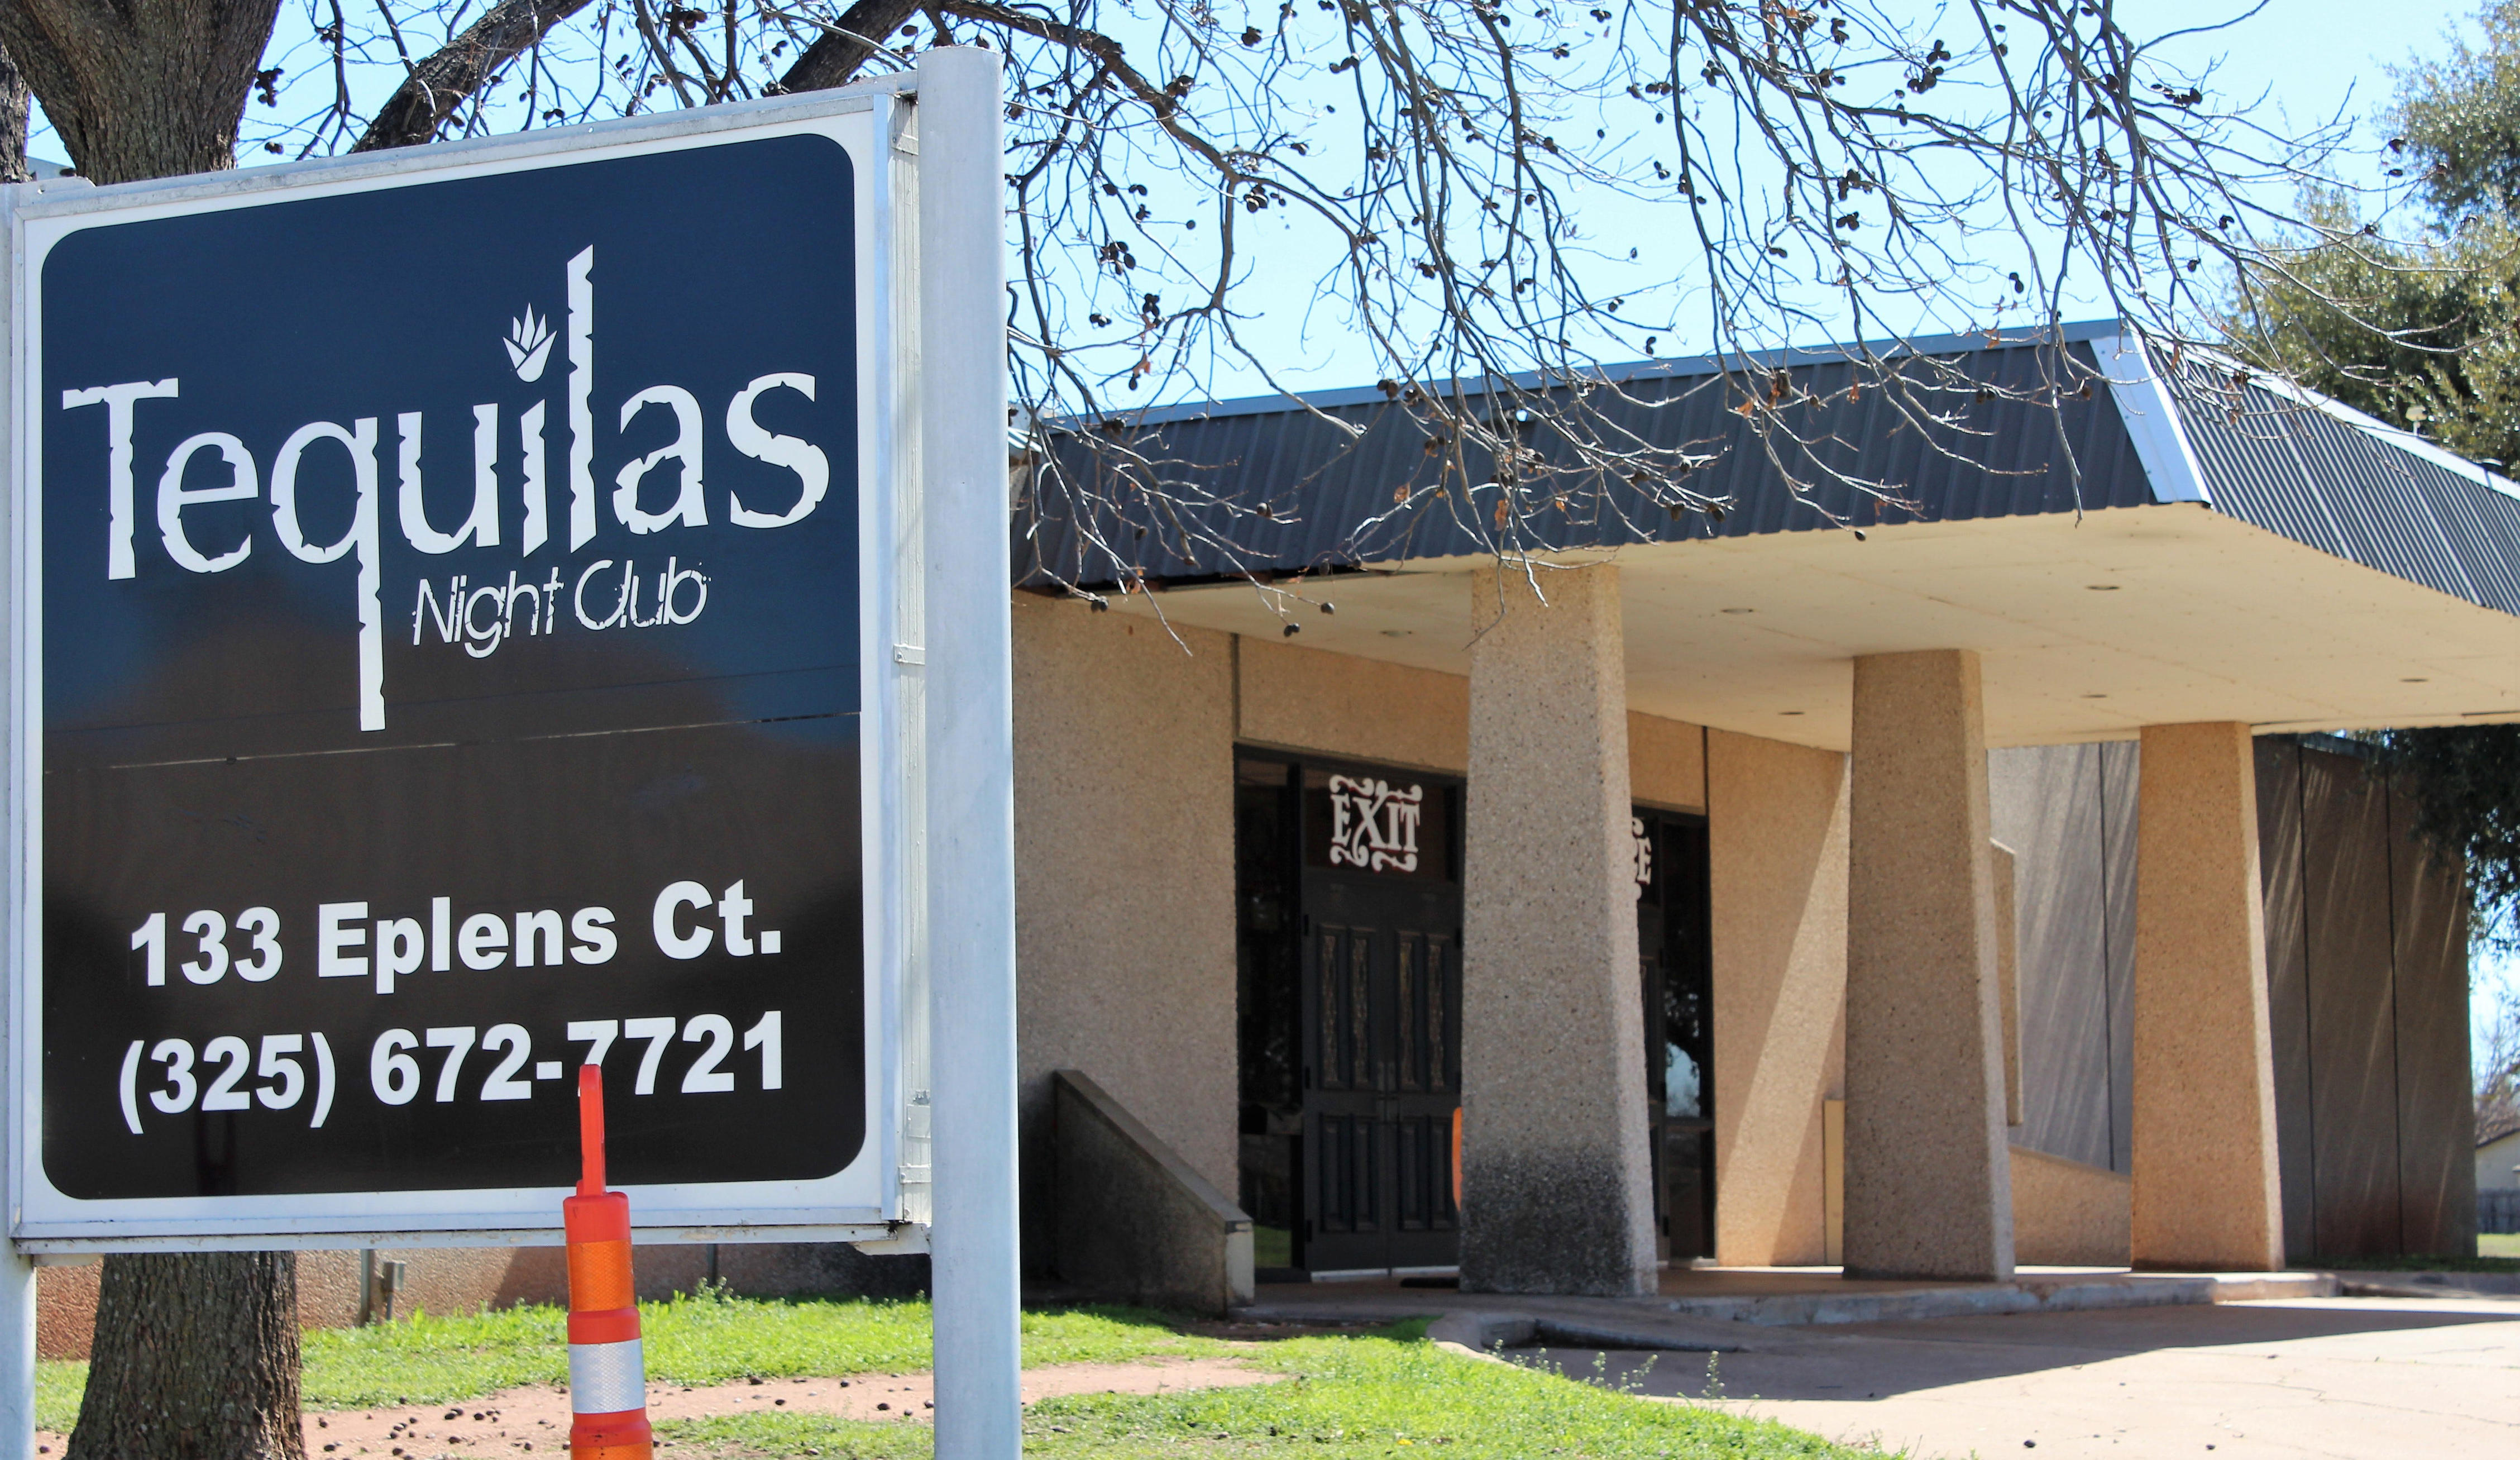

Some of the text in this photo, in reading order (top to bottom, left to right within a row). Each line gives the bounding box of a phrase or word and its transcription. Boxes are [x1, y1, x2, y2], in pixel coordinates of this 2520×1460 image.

[62, 244, 830, 732] Tequilas
[412, 556, 709, 658] Night Club
[1330, 777, 1422, 870] EXIT
[131, 880, 782, 995] 133 Eplens Ct.
[119, 1010, 782, 1135] (325) 672-7721
